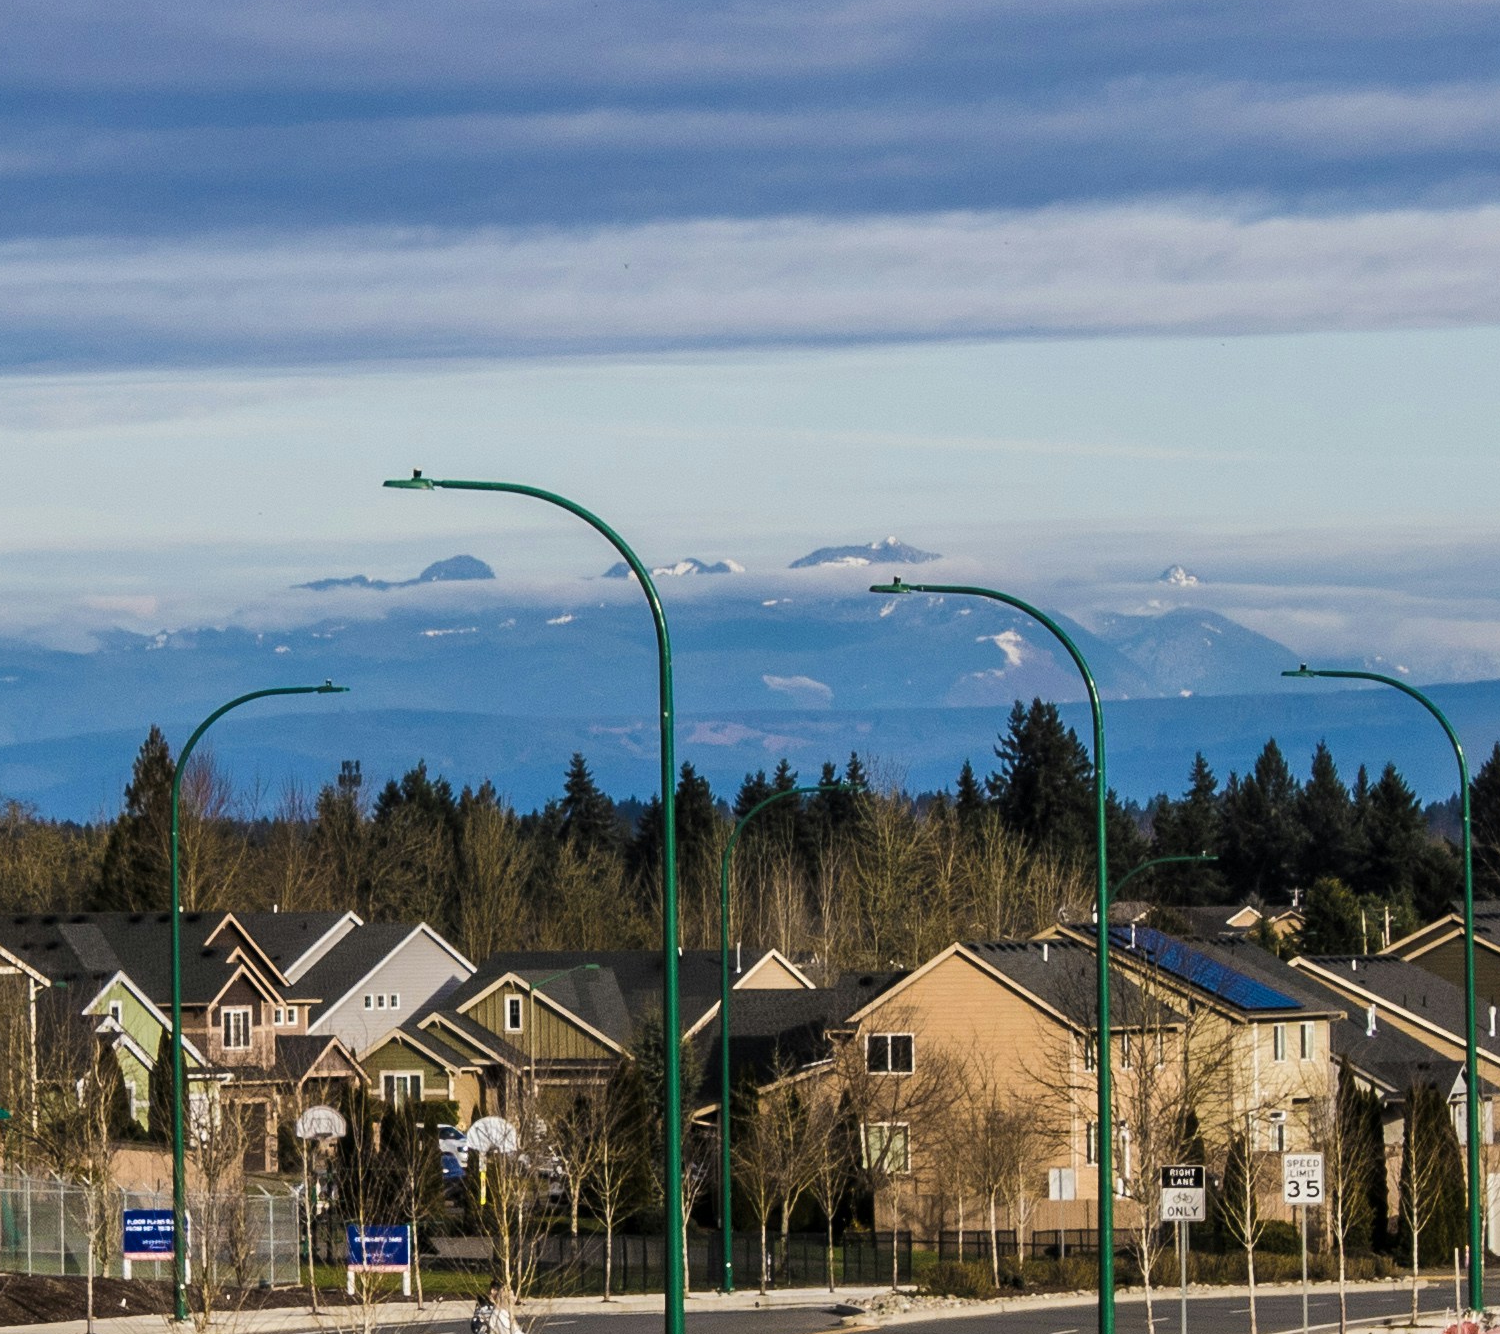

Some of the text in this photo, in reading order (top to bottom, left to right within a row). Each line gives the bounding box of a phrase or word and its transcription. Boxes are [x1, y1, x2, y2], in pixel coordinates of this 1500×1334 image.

[1286, 1159, 1320, 1168] SPEED
[1170, 1168, 1196, 1177] RIGHT
[1290, 1169, 1316, 1178] LIMIT
[1171, 1178, 1195, 1186] LANE
[1287, 1180, 1320, 1198] 35
[1167, 1206, 1199, 1217] ONLY
